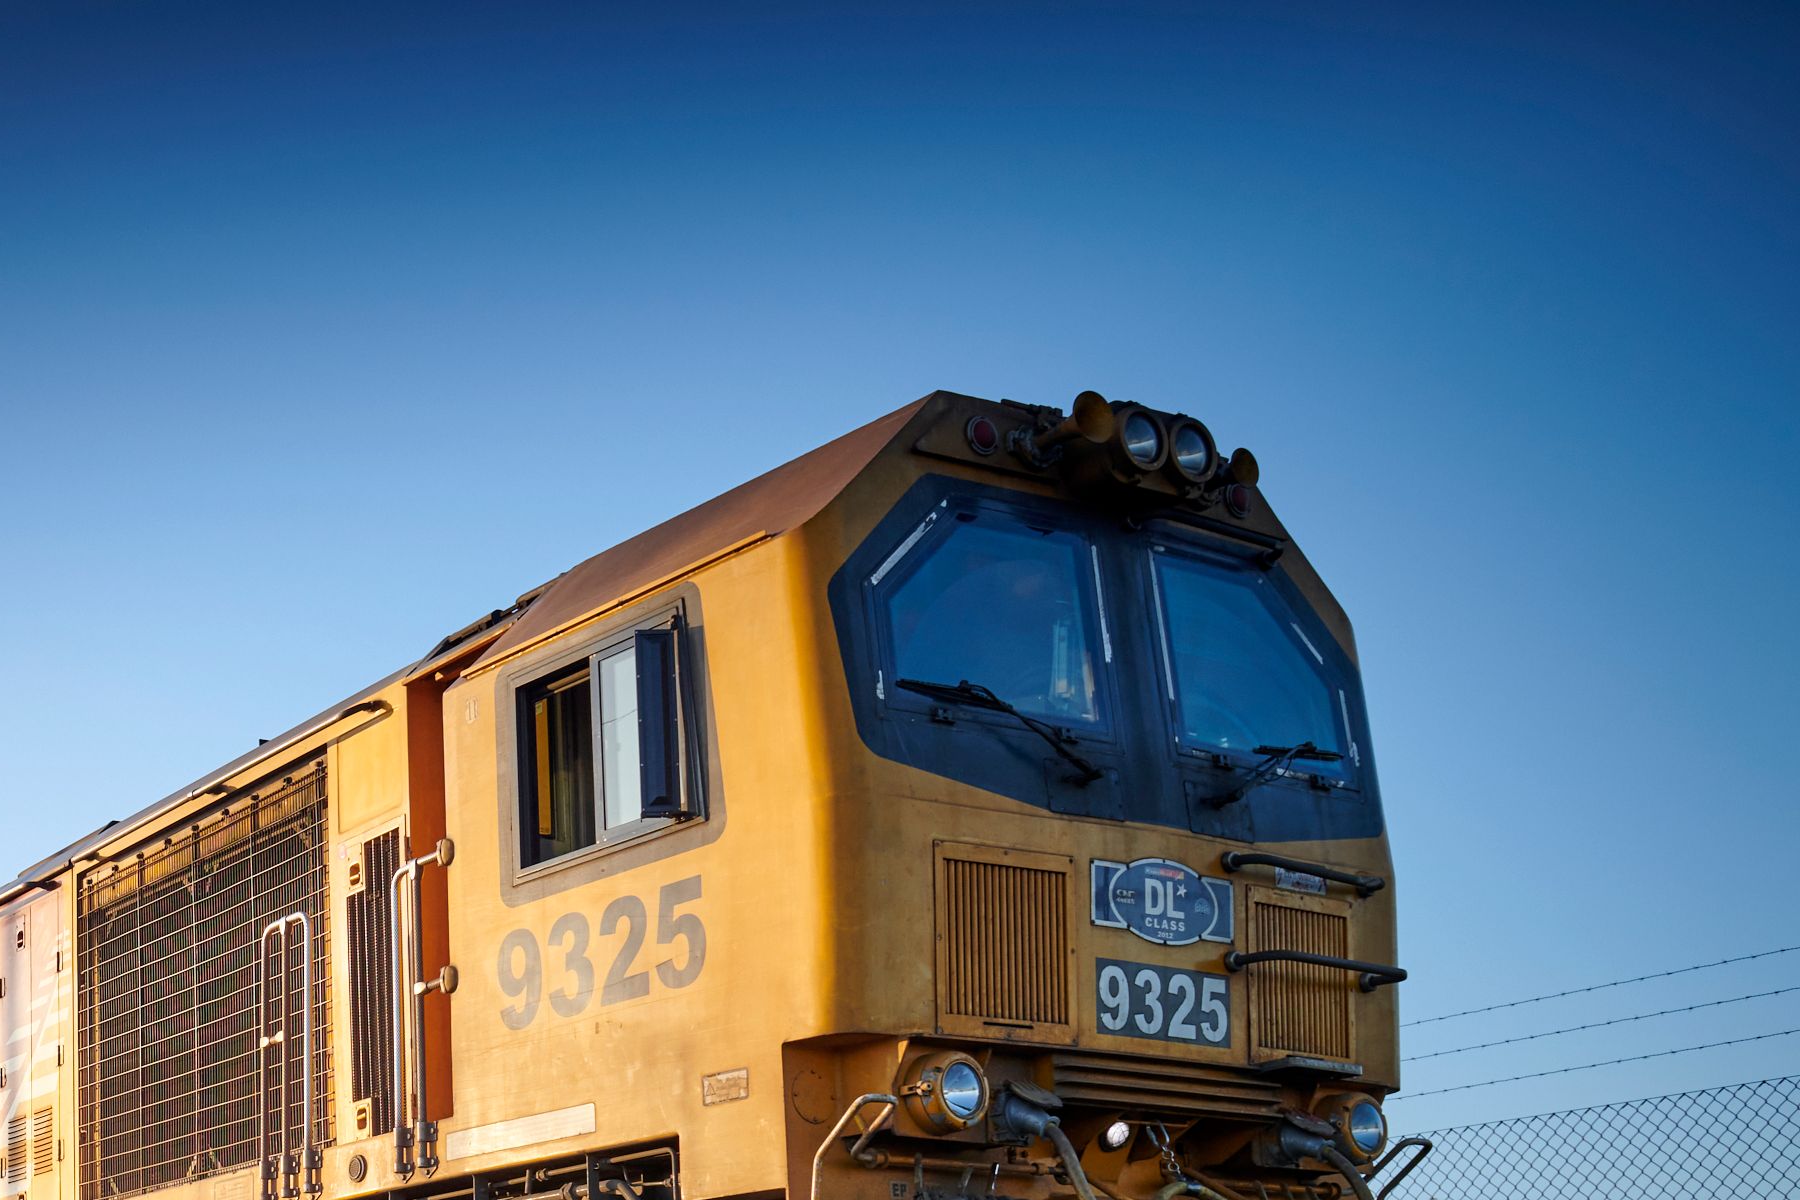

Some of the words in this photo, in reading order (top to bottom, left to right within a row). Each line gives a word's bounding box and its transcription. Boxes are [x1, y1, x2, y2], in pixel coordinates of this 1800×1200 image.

[1145, 878, 1184, 919] DL
[1145, 917, 1185, 932] CLASS
[1157, 931, 1174, 939] 2012
[497, 874, 707, 1031] 9325
[1099, 965, 1228, 1043] 9325
